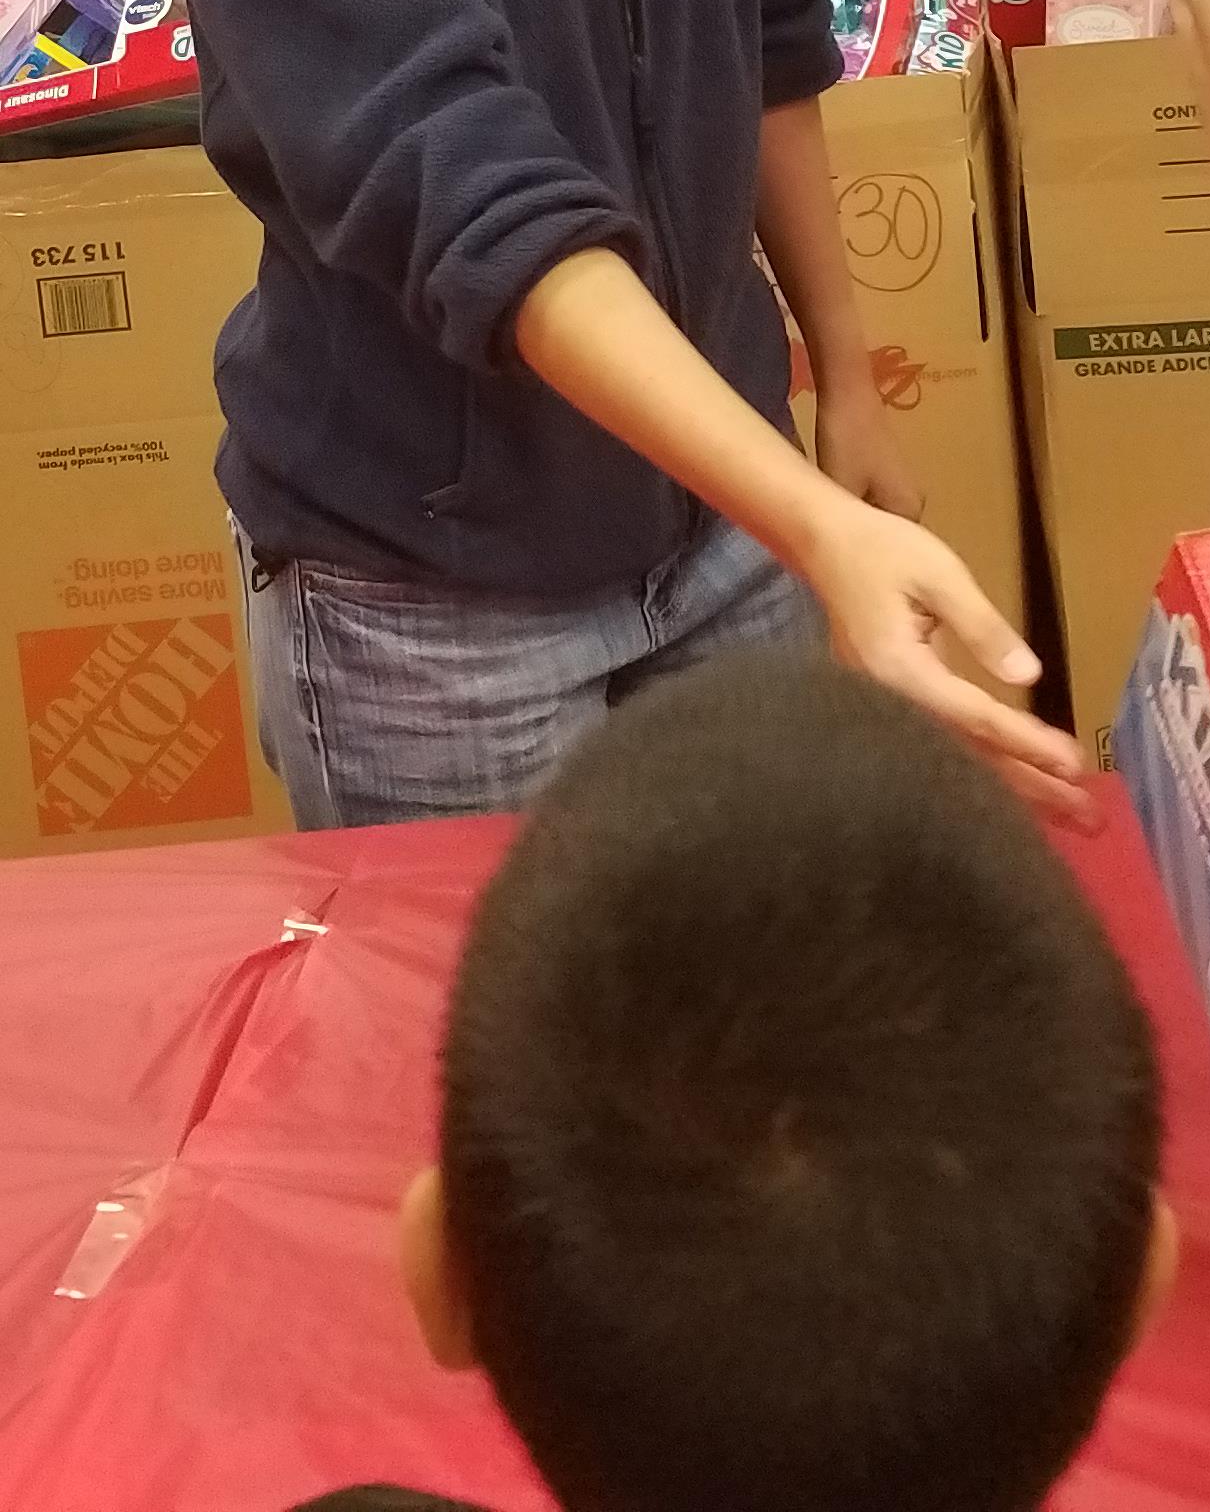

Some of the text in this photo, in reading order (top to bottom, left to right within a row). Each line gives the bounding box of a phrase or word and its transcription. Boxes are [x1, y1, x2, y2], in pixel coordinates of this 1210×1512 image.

[935, 34, 965, 69] KID
[5, 84, 70, 109] Dinosaur
[847, 182, 928, 260] 30
[31, 241, 126, 267] 115 733
[1088, 331, 1165, 352] EXTRA
[1075, 358, 1157, 378] GRANDE
[79, 443, 128, 457] recycled
[107, 455, 118, 466] is
[147, 450, 169, 462] This
[38, 459, 68, 471] from
[70, 457, 105, 469] made
[68, 551, 224, 582] More doing.
[60, 579, 227, 610] More saving.
[28, 624, 149, 759] DEPOT
[36, 617, 236, 833] HOME
[140, 720, 224, 804] THE
